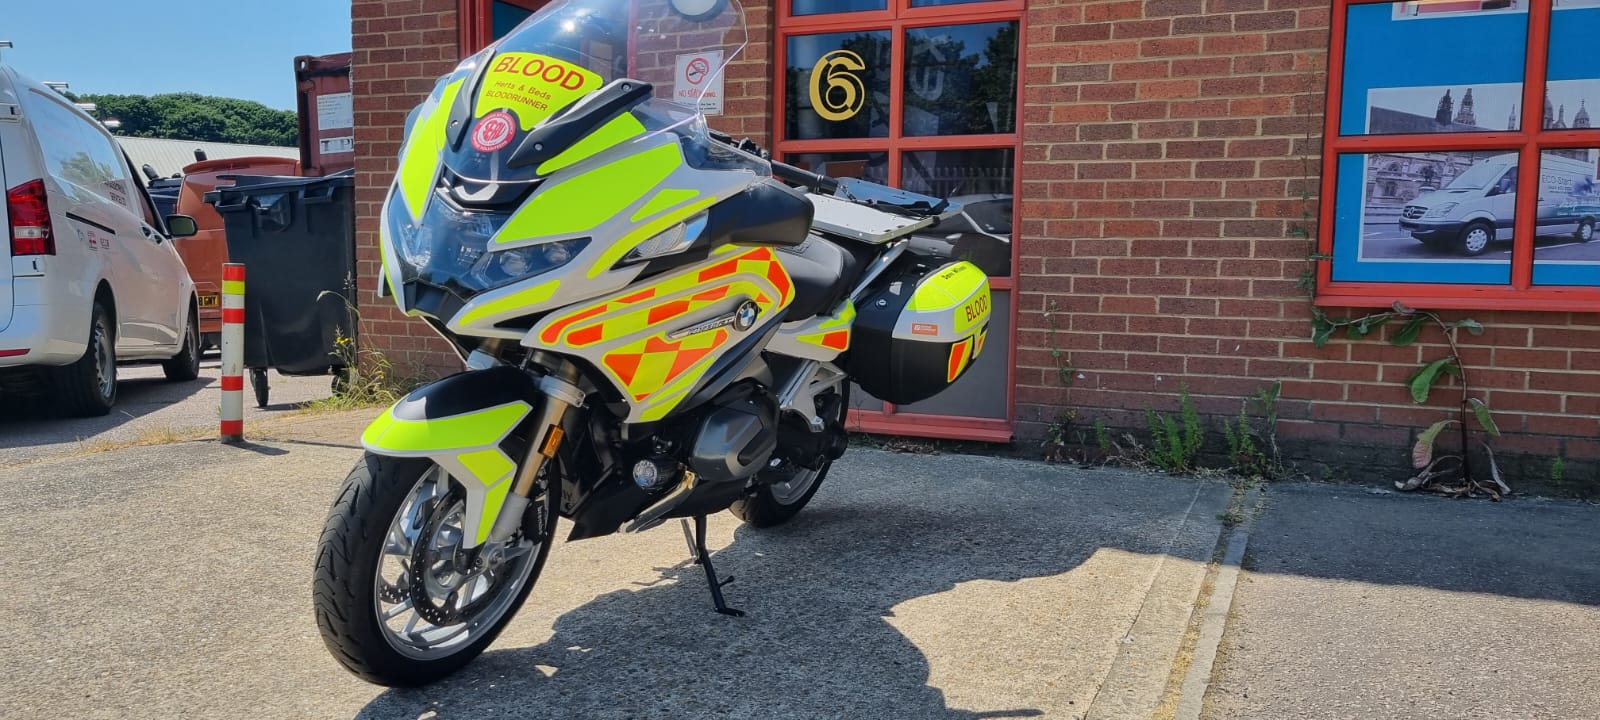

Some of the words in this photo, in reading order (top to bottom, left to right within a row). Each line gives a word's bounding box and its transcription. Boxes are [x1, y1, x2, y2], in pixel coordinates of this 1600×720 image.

[493, 56, 585, 91] BLOOD
[809, 49, 866, 121] 6
[485, 90, 549, 112] BLOODRUNNER
[494, 80, 516, 90] Herts
[518, 84, 525, 92] &
[528, 85, 552, 100] Beds
[965, 293, 988, 322] BLOOD
